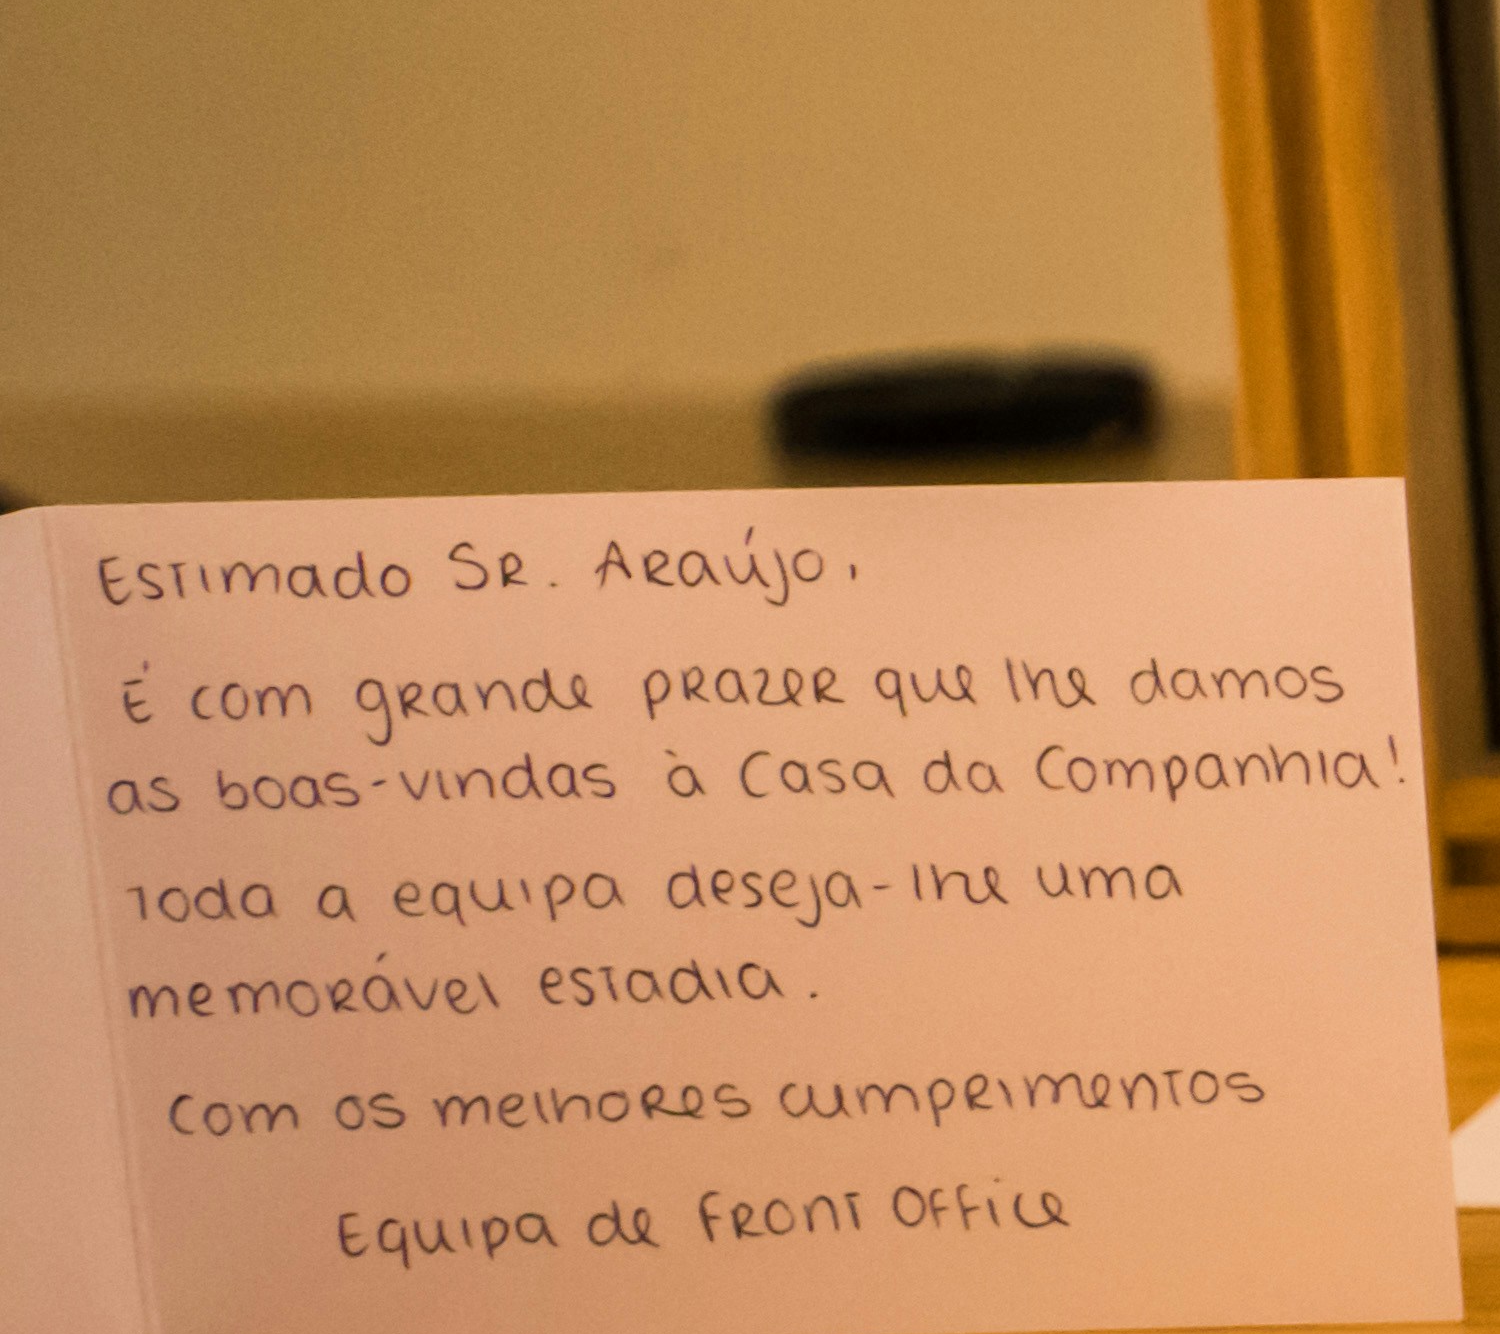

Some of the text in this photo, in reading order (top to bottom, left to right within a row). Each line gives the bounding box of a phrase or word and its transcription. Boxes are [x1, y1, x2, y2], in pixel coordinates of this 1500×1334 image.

[98, 550, 412, 607] Estimado
[122, 656, 1347, 749] É com grande prazer que lhe damos
[106, 733, 1408, 816] as boas-vindas à Casa da Companhia!
[316, 884, 358, 924] a
[392, 870, 627, 928] equipa
[666, 861, 1011, 930] deseja-lhe
[1035, 861, 1185, 901] uma
[127, 951, 821, 1020] memorável estadia.
[334, 1091, 407, 1133] os
[431, 1080, 753, 1131] melhores
[777, 1067, 1269, 1129] cumprimentos
[336, 1208, 560, 1271] Equipa
[586, 1198, 663, 1247] de
[891, 1177, 1073, 1232] Office
